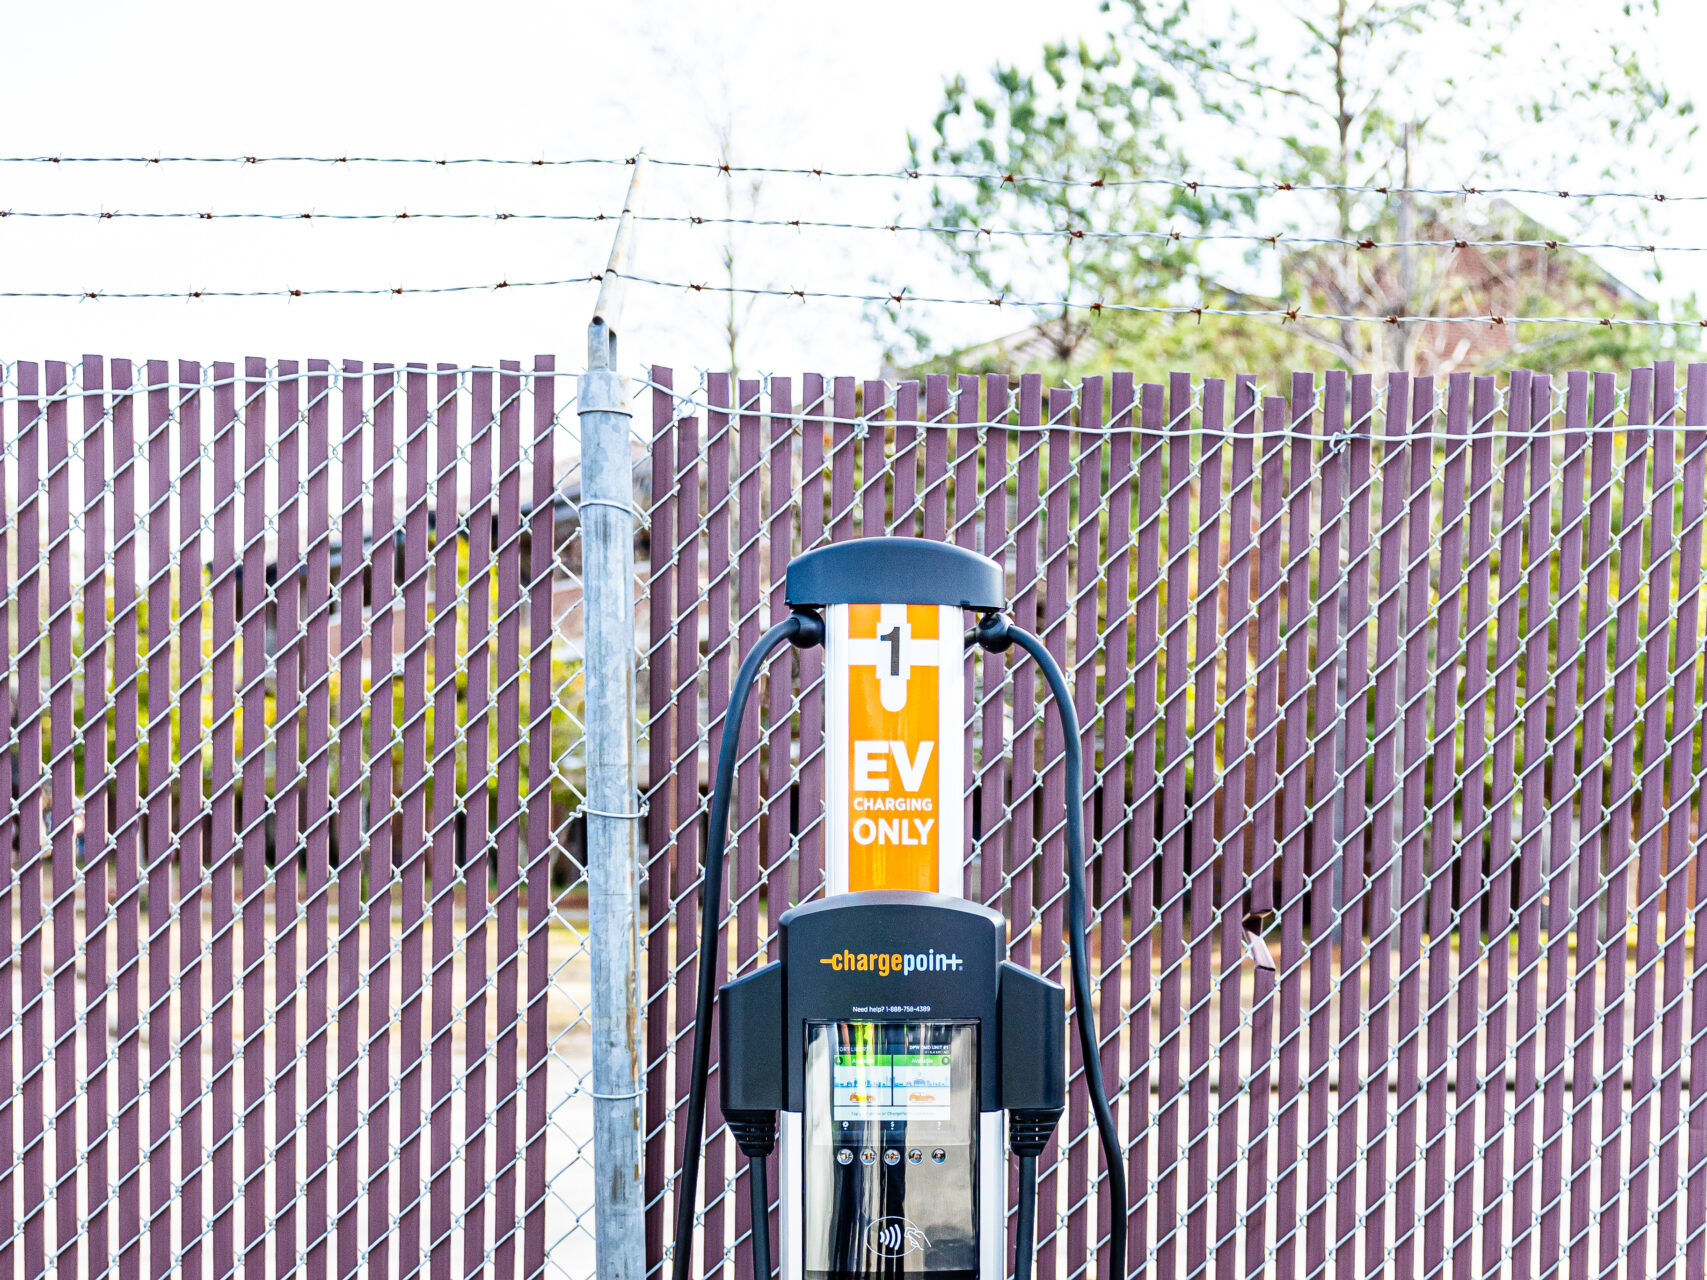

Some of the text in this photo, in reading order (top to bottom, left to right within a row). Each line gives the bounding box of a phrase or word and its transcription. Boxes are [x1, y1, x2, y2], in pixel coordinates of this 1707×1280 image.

[880, 626, 901, 677] 1
[853, 740, 936, 792] EV
[853, 797, 933, 812] CHARGING
[852, 817, 936, 846] ONLY
[852, 1005, 868, 1013] Need
[869, 1005, 885, 1014] help?
